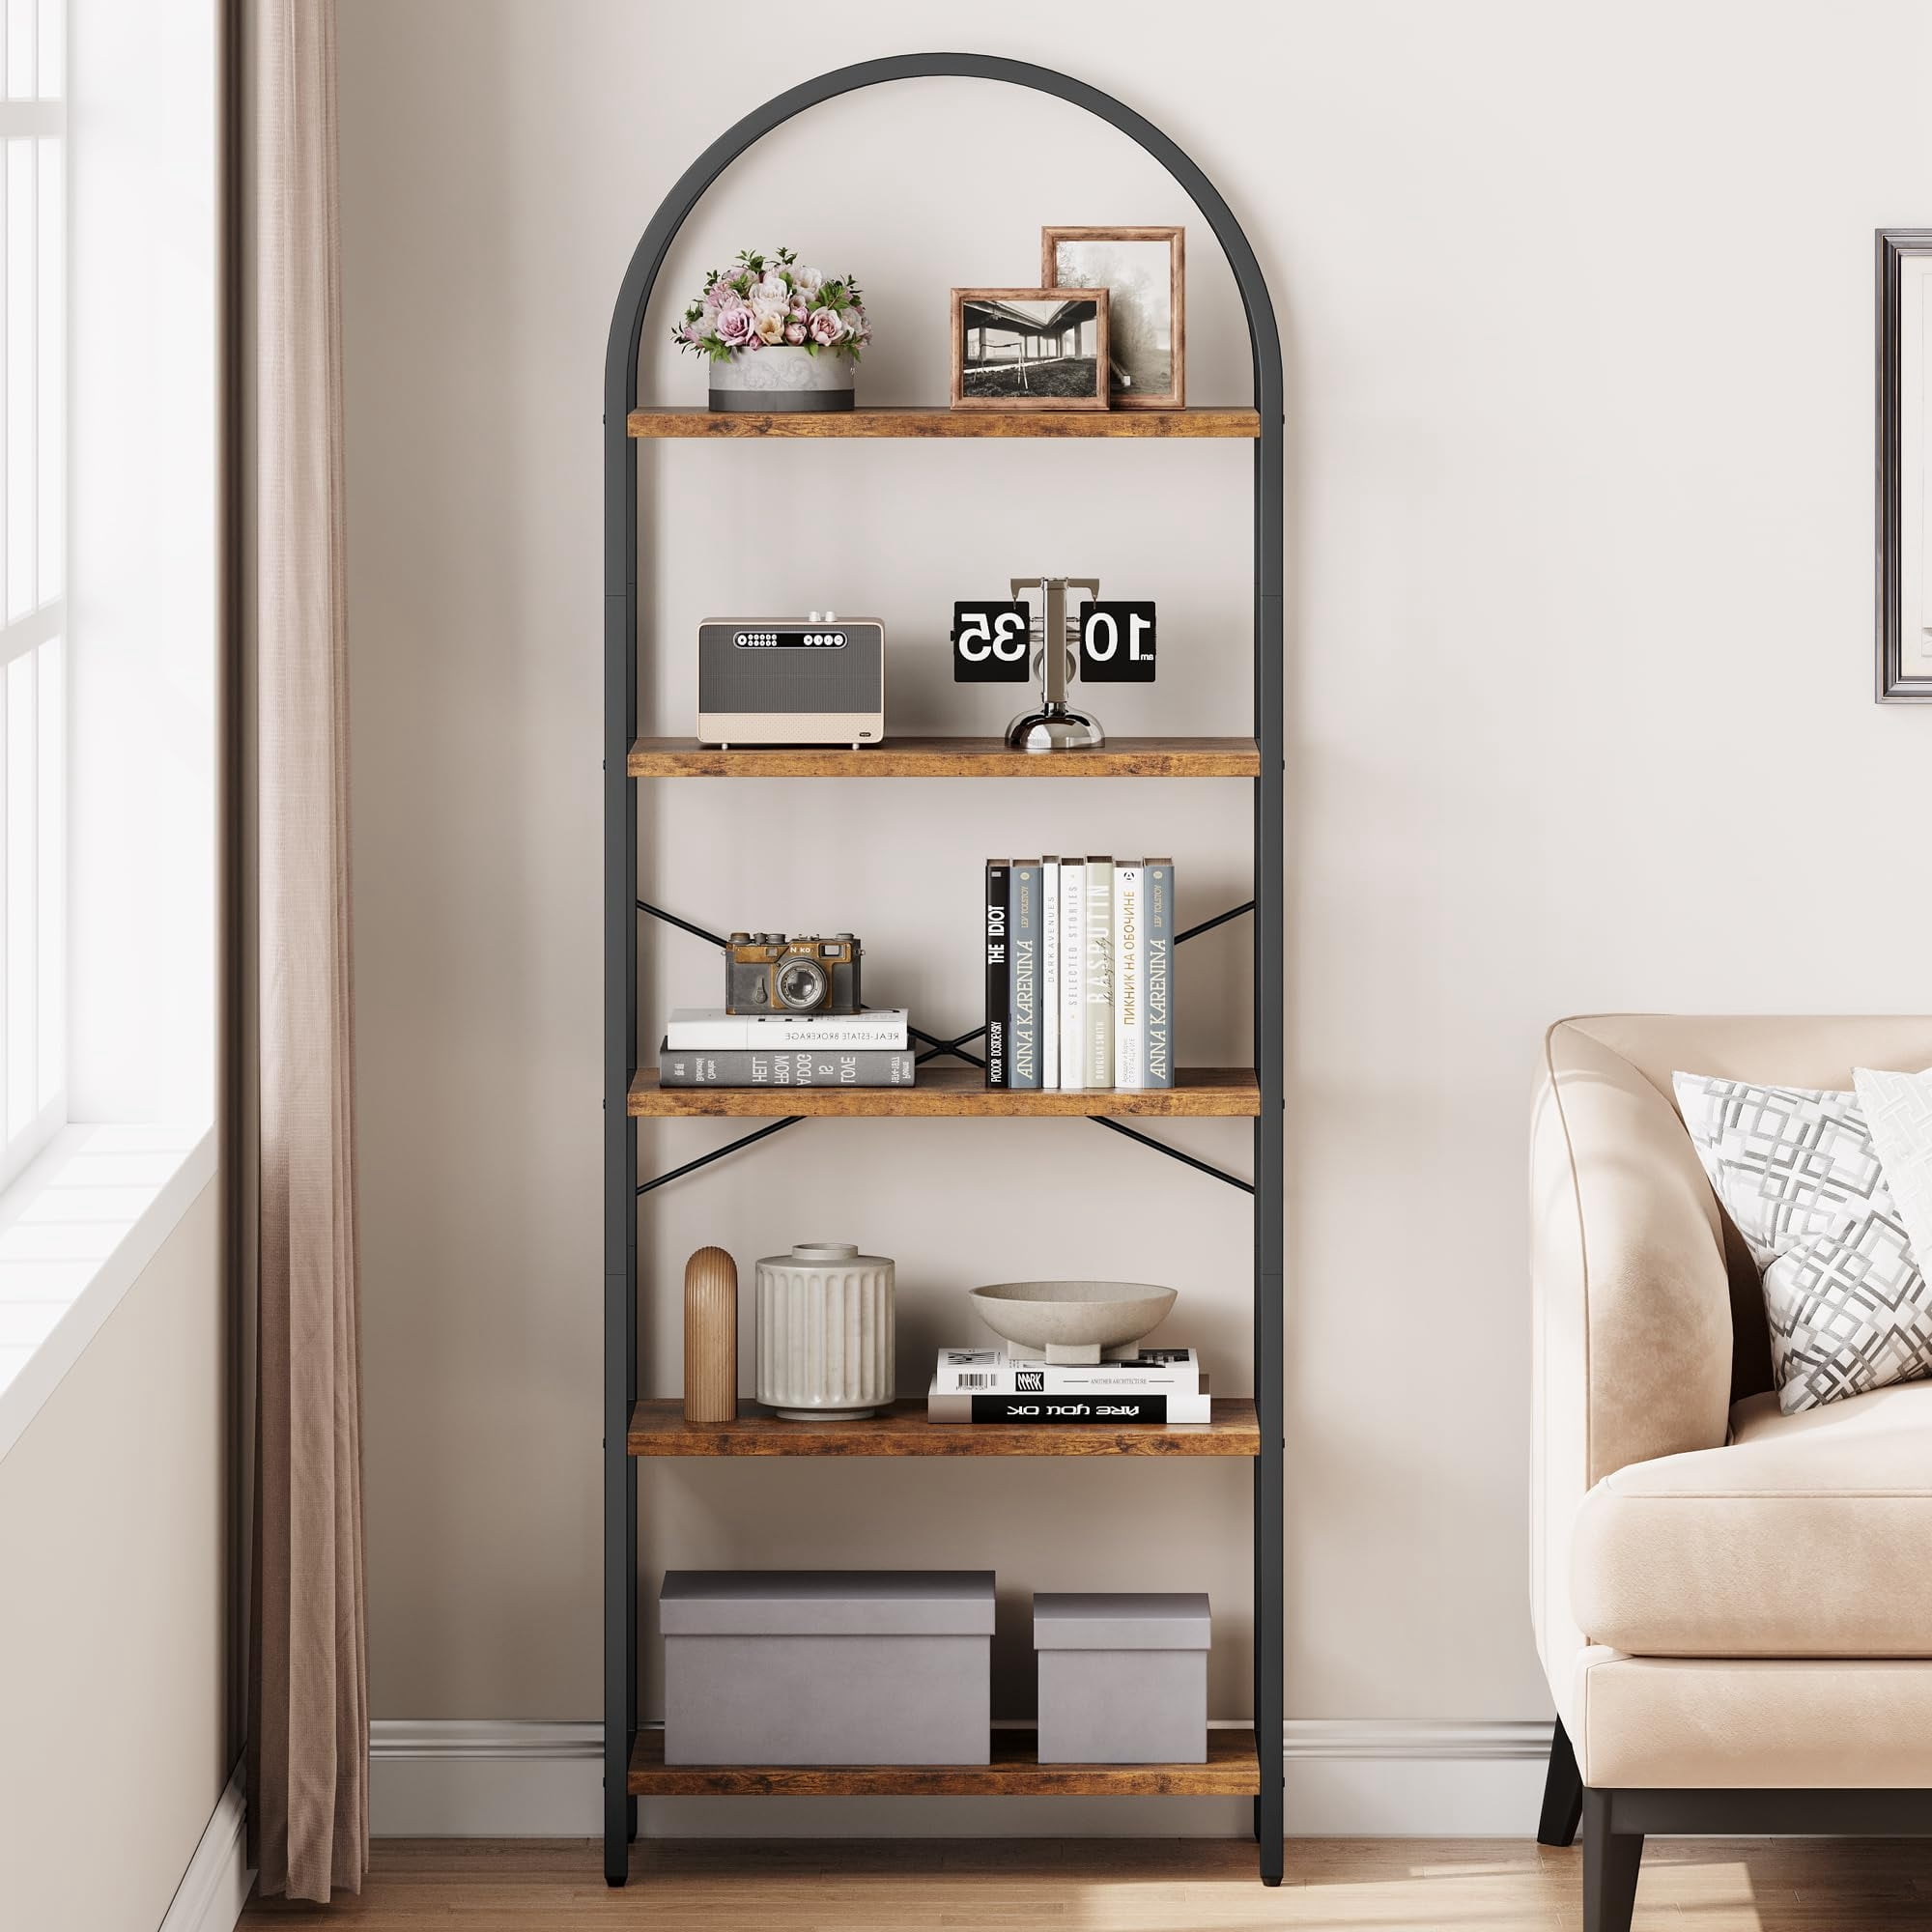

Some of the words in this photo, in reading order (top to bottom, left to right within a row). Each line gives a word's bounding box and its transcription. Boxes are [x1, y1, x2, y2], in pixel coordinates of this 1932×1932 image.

[988, 905, 1005, 936] IDIOT
[1068, 886, 1077, 938] STORIES
[1123, 891, 1135, 950] ОБОЧИНЕ
[1153, 885, 1162, 915] TOLSTOY
[988, 944, 1005, 964] THE
[1087, 885, 1109, 1004] RASPUTIN
[1123, 953, 1135, 971] НА
[1016, 940, 1033, 1026] KARENINA
[1068, 947, 1077, 1006] SELECTED
[1150, 939, 1166, 1025] KARENINA
[1123, 974, 1135, 1025] ПИКНИК
[1095, 1021, 1105, 1044] SMITH
[991, 1058, 1002, 1083] FYODOR
[1016, 1030, 1033, 1080] ANNA
[1095, 1045, 1105, 1080] DOUGLAS
[1150, 1030, 1166, 1080] ANNA
[1017, 1373, 1043, 1391] MARK
[1007, 1406, 1039, 1416] OK
